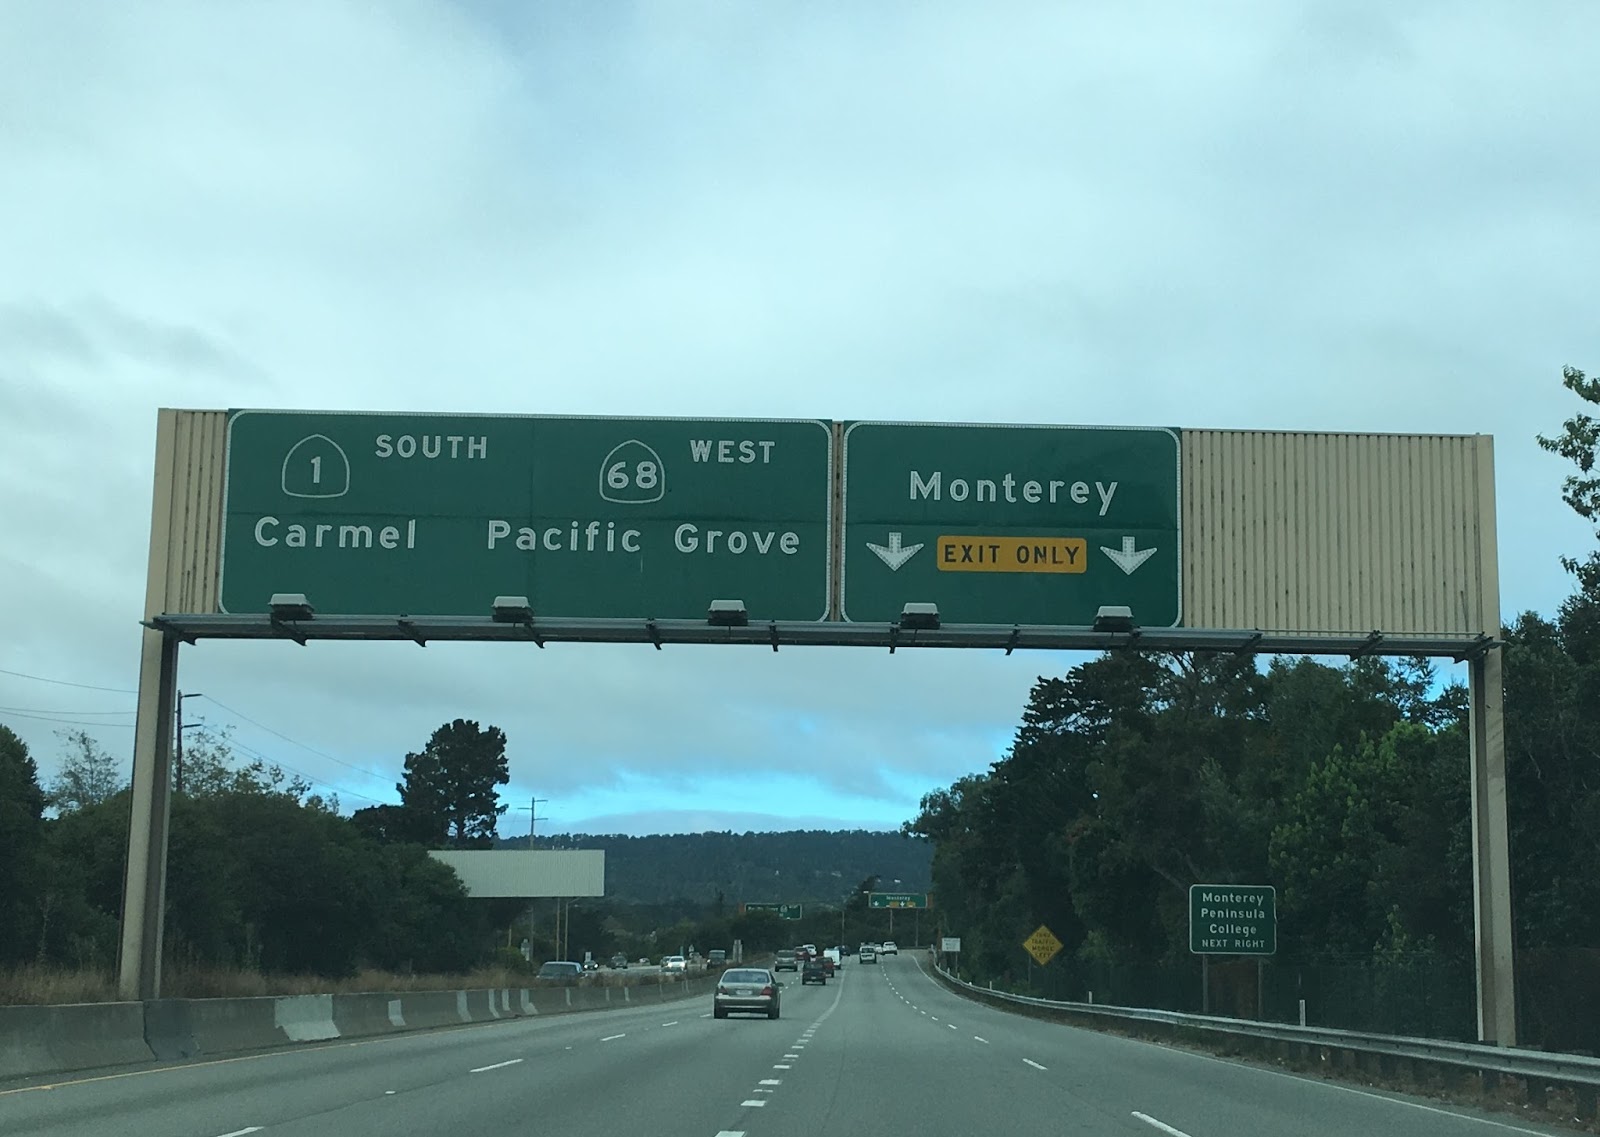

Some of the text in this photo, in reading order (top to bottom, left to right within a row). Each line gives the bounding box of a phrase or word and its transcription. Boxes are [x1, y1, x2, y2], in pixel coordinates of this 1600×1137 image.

[375, 434, 488, 460] SOUTH
[690, 439, 776, 464] WEST
[310, 456, 322, 484] 1
[607, 461, 658, 490] 68
[909, 470, 1118, 516] Monterey
[254, 516, 416, 549] Carmel
[487, 519, 800, 555] Pacific Grove
[944, 544, 1080, 565] EXIT ONLY
[1202, 892, 1264, 907] Monterey
[1201, 907, 1265, 919] Peninsula
[1209, 923, 1257, 938] College
[1202, 939, 1265, 948] NEXT RIGHT
